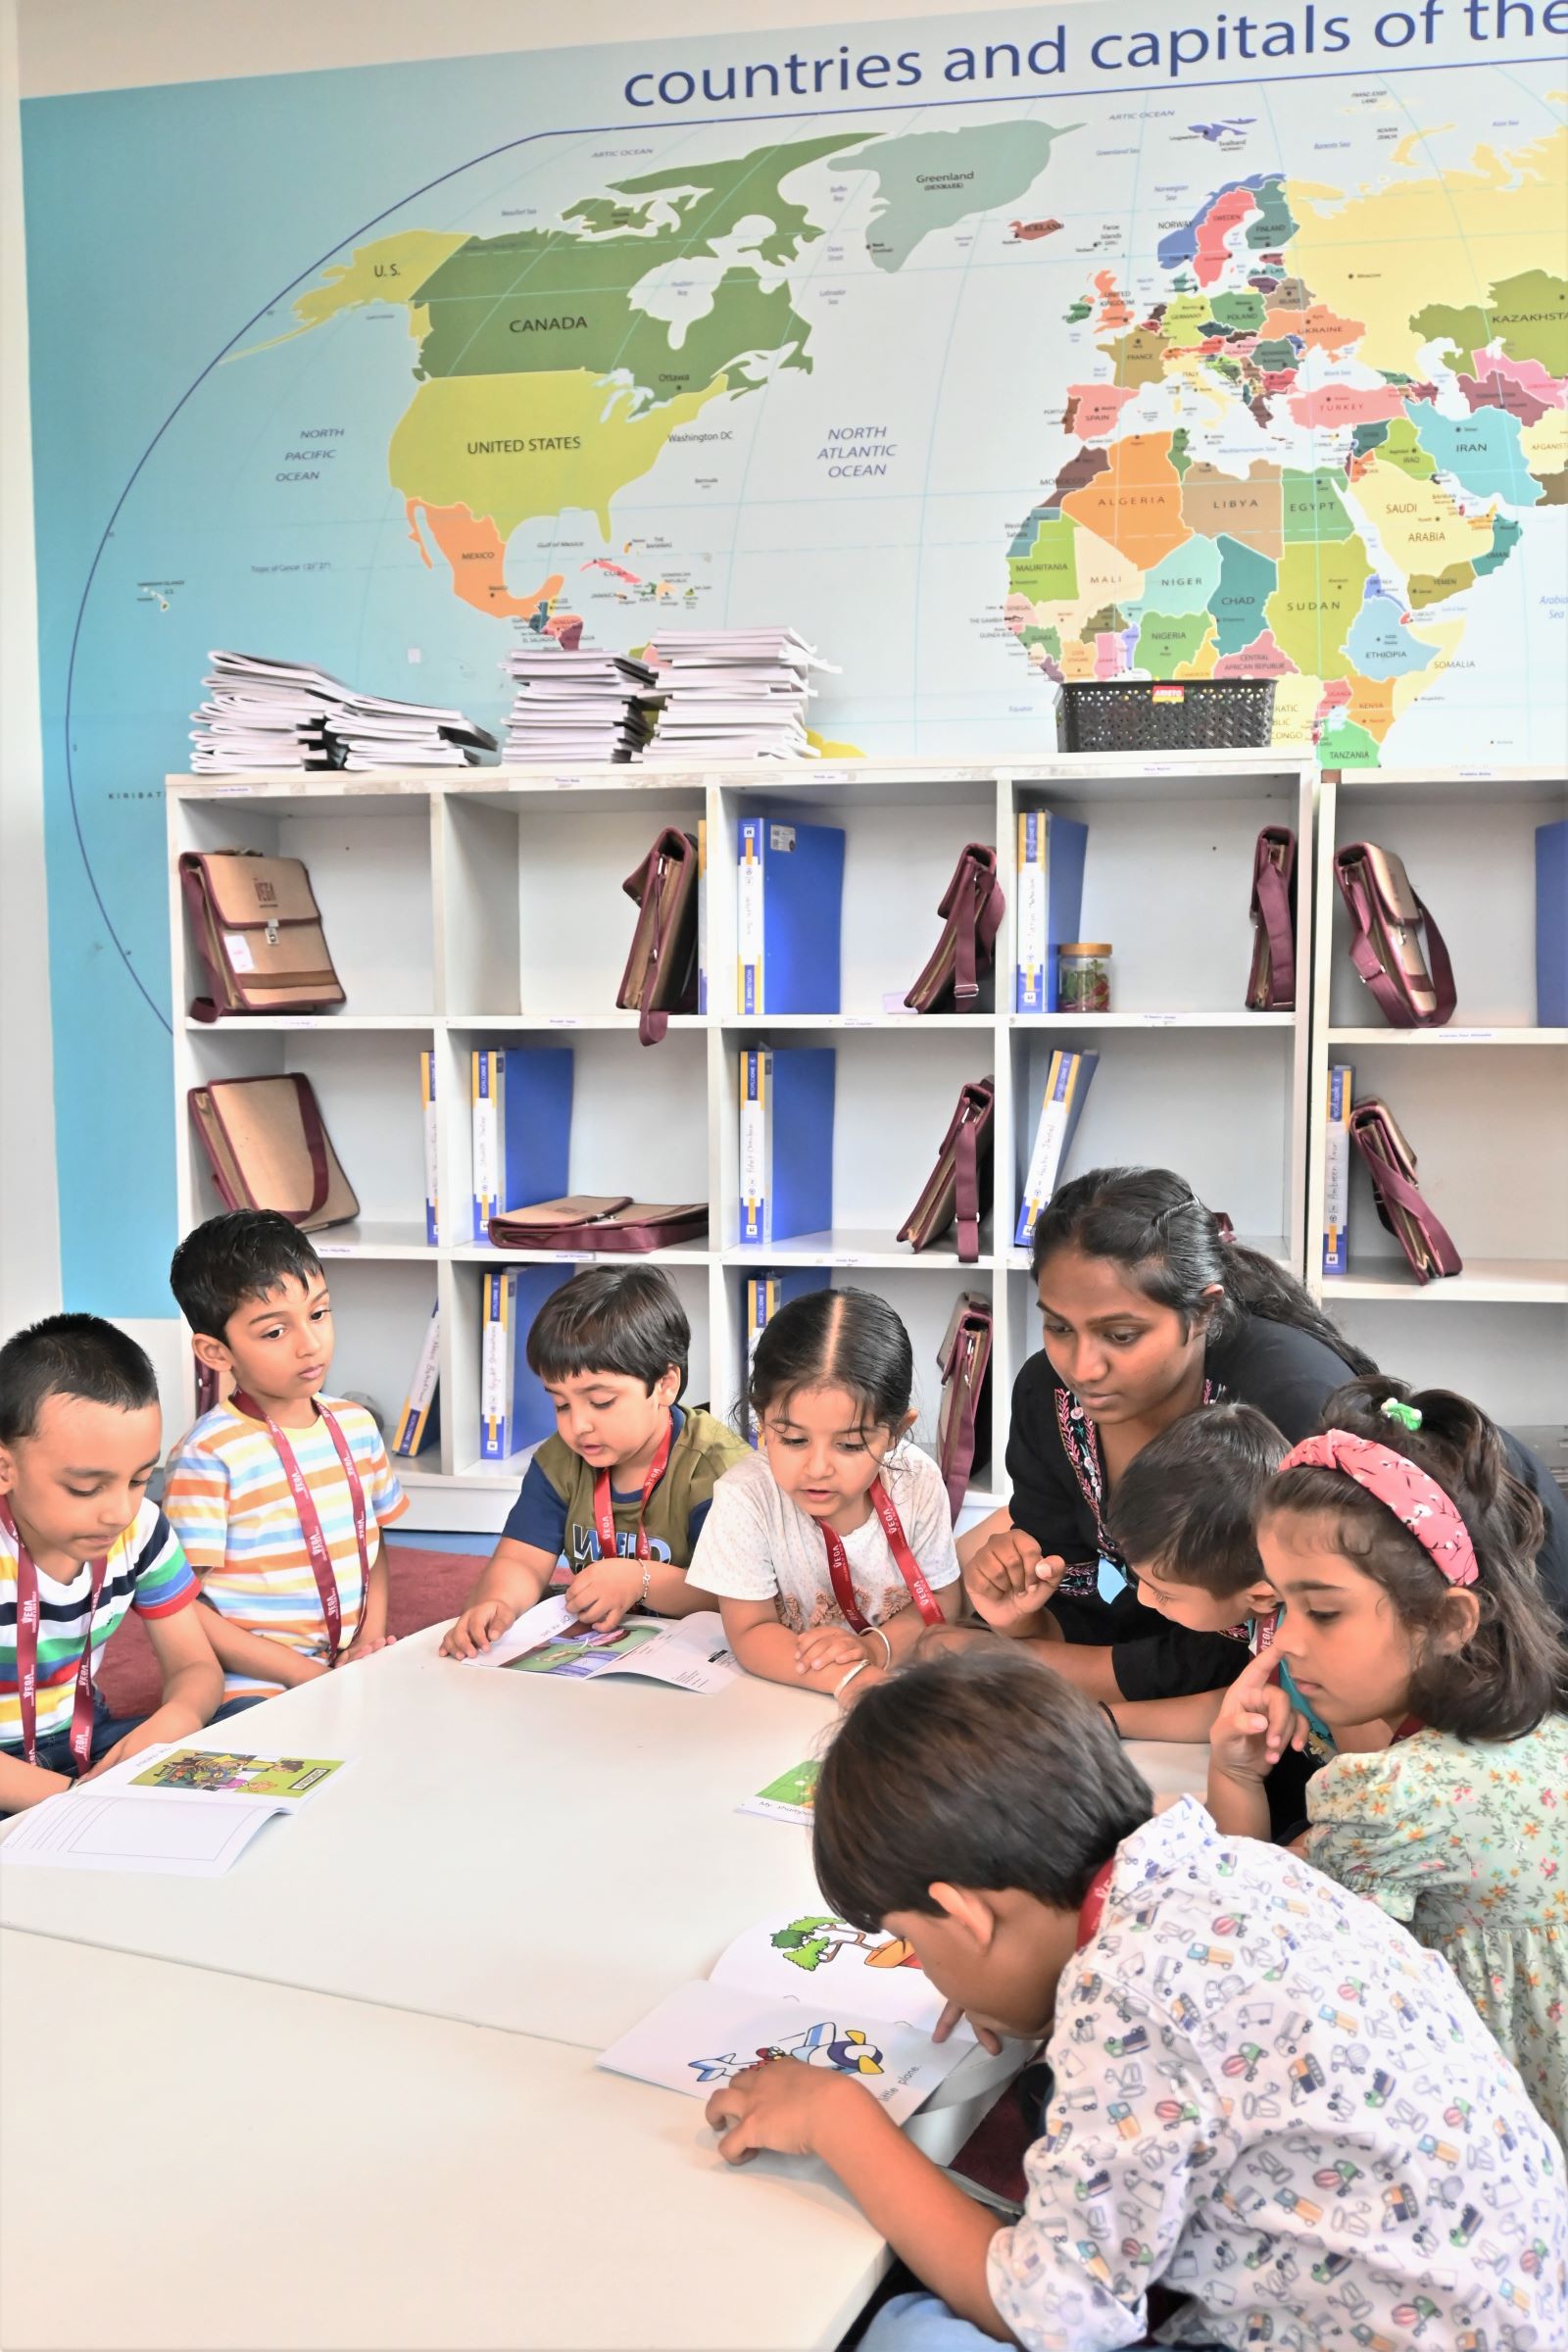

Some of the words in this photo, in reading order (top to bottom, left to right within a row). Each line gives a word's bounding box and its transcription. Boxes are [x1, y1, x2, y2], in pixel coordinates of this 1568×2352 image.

[624, 46, 922, 107] countries
[944, 24, 1066, 82] and
[1091, 4, 1351, 77] capitals
[1375, 0, 1444, 48] of
[1464, 0, 1568, 40] the
[1139, 110, 1175, 119] OCEAN
[619, 148, 654, 157] OCEAN
[915, 171, 974, 184] Greenland
[1213, 214, 1242, 222] SWEDEN
[1157, 221, 1194, 230] NORWAY
[1255, 224, 1287, 233] FINLAND
[373, 264, 388, 278] U.
[389, 264, 401, 276] S.
[1227, 313, 1259, 321] POLAND
[509, 316, 589, 334] CANADA
[1298, 325, 1345, 335] UKRAINE
[659, 372, 691, 383] Ottawa
[1319, 403, 1365, 413] TURKEY
[1085, 414, 1111, 422] SPAIN
[300, 427, 346, 440] NORTH
[668, 431, 719, 444] Washington
[720, 430, 734, 441] DC
[827, 425, 888, 441] NORTH
[466, 438, 525, 456] UNITED
[528, 436, 582, 453] STATES
[816, 443, 899, 461] ATLANTIC
[1455, 443, 1489, 453] IRAN
[284, 448, 337, 462] PACIFIC
[275, 470, 321, 483] OCEAN
[827, 464, 888, 478] OCEAN
[1098, 495, 1167, 508] ALGERIA
[1213, 499, 1260, 510] LIBYA
[1290, 501, 1337, 513] EGYPT
[1386, 503, 1418, 514] SAUDI
[1407, 531, 1446, 543] ARABIA
[462, 550, 495, 561] MEXICO
[1015, 563, 1069, 572] MAURITANIA
[1090, 575, 1123, 585] MALI
[1161, 577, 1203, 587] NIGER
[1432, 577, 1457, 586] YEMEN
[1221, 596, 1255, 607] CHAD
[1287, 601, 1342, 612] SUDAN
[1547, 609, 1565, 619] Sea
[1152, 631, 1187, 641] NIGERIA
[1366, 650, 1407, 660] ETHIOPIA
[1434, 660, 1476, 670] SOMALIA
[1330, 751, 1370, 760] TANZANIA
[108, 791, 166, 800] KIRIBAT
[291, 1470, 305, 1494] VEGA
[882, 1506, 897, 1535] VEGA
[602, 1515, 612, 1541] VEGA
[309, 1531, 324, 1557] VEGA
[913, 1579, 930, 1606] VEGA
[23, 1599, 34, 1625] VEGA
[325, 1595, 338, 1618] VEGA
[1260, 1626, 1271, 1650] VEGA
[77, 1664, 90, 1687] VEGA
[24, 1673, 34, 1702] VEGA
[74, 1733, 86, 1755] VEGA
[877, 2087, 900, 2102] little
[898, 2065, 923, 2086] plane.
